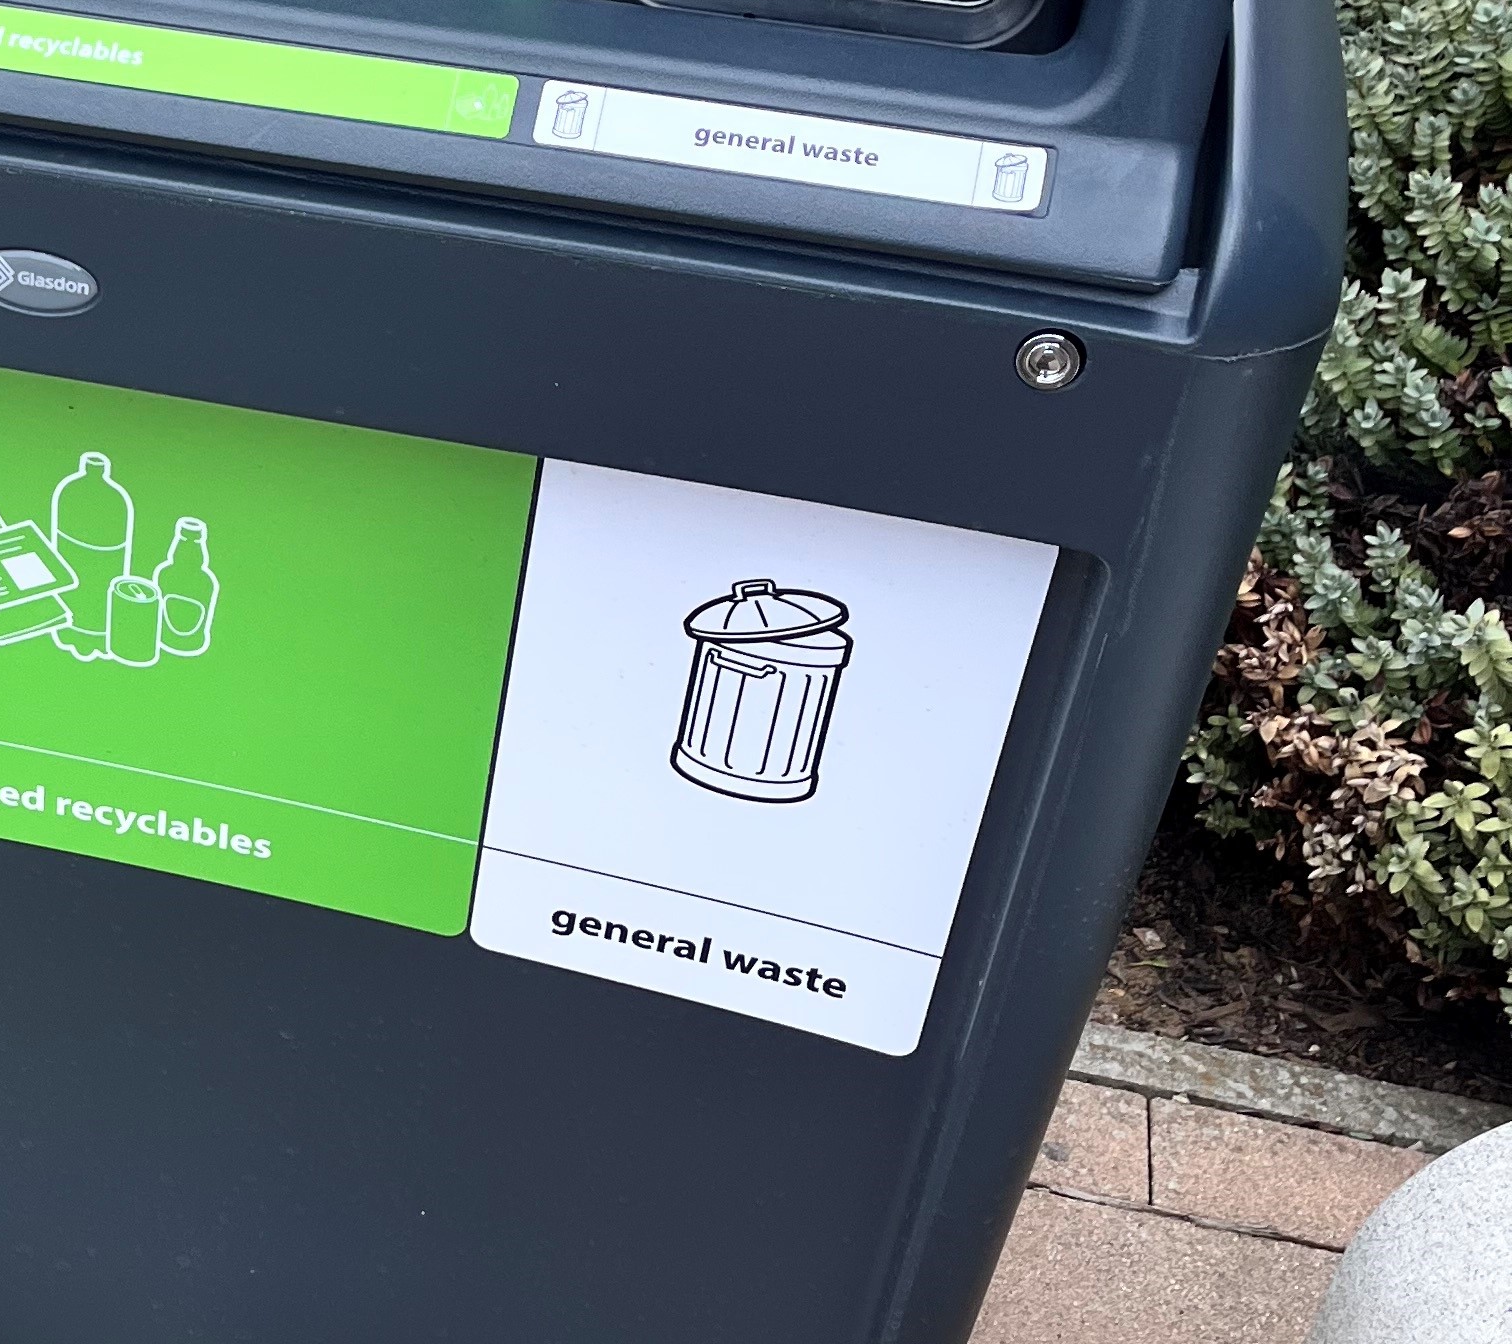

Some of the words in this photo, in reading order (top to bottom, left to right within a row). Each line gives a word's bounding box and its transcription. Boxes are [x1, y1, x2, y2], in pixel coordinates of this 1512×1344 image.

[8, 30, 144, 66] recyclables
[694, 125, 795, 155] general
[802, 142, 879, 167] waste
[17, 269, 90, 296] Glasdon
[56, 794, 272, 859] recyclables
[551, 908, 712, 964] general
[723, 949, 847, 999] waste
